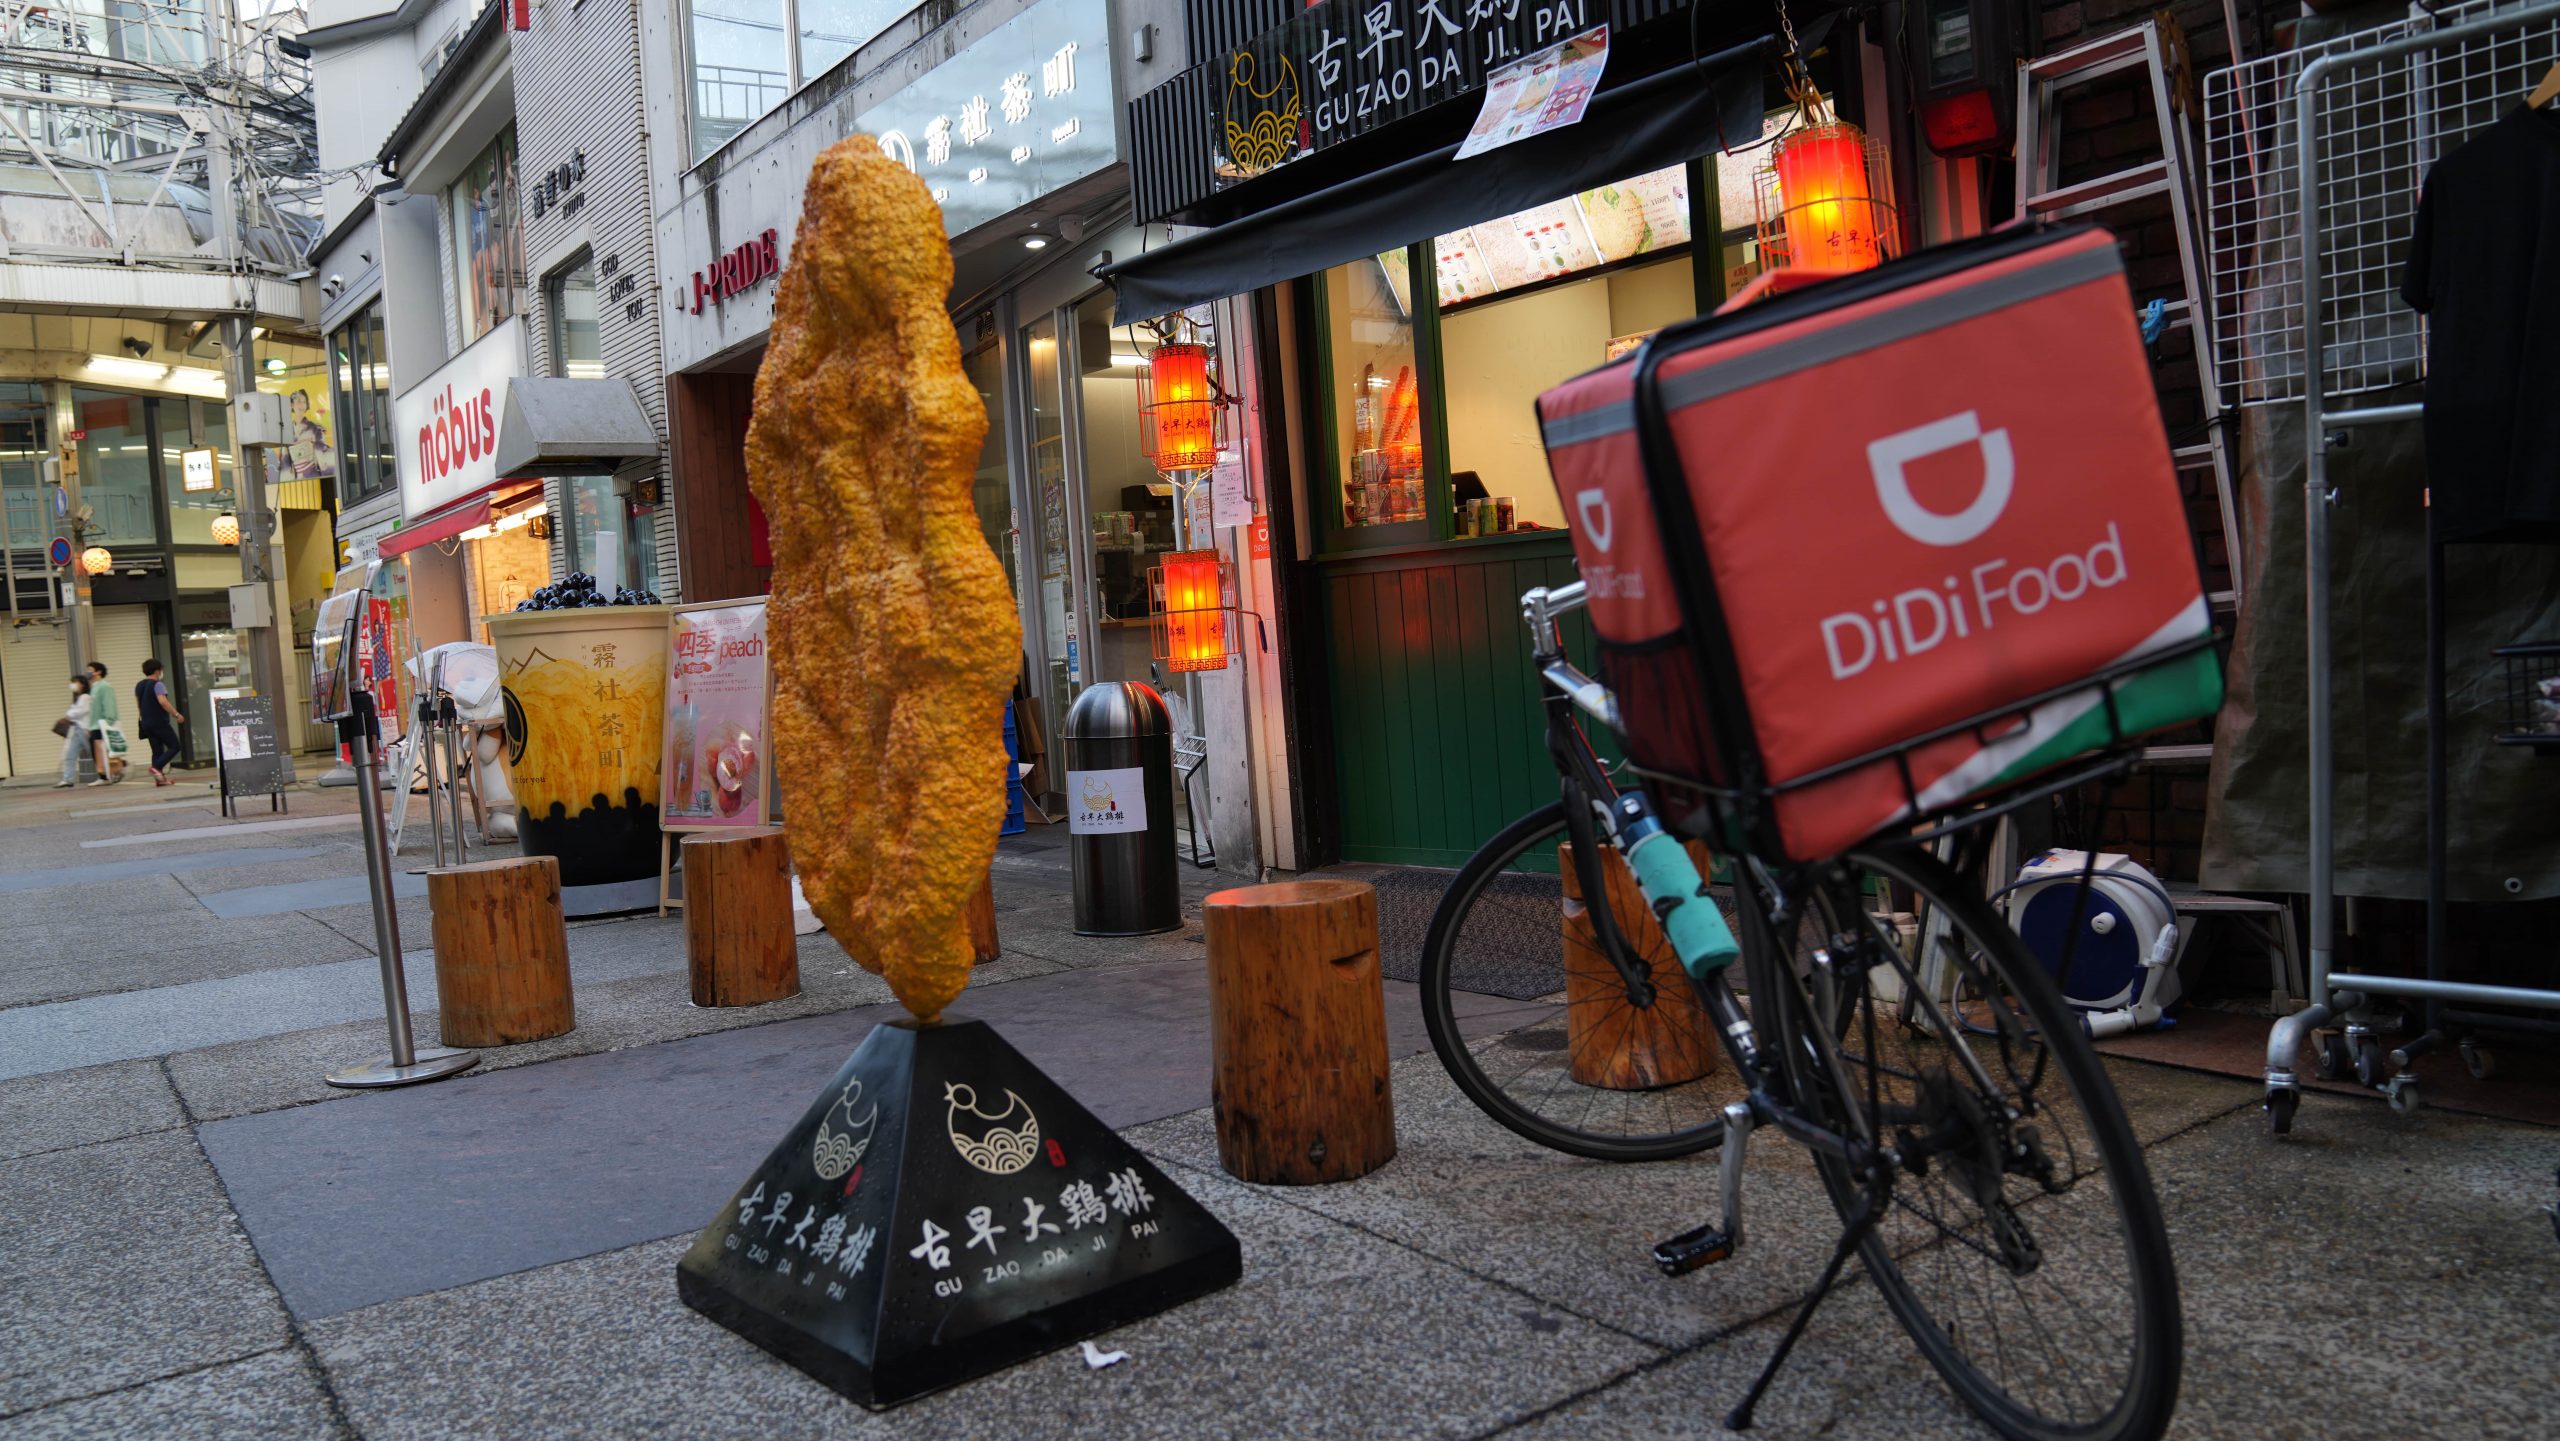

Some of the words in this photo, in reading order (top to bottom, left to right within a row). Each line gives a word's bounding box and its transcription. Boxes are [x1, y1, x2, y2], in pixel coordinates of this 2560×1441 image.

[1315, 92, 1350, 132] GU
[1356, 68, 1411, 118] ZAO
[1421, 48, 1461, 91] DA
[1536, 0, 1585, 43] PAI
[602, 254, 619, 277] GOD
[610, 274, 635, 302] LOVES
[691, 228, 779, 315] J-PRIDE
[626, 298, 643, 322] YOU
[419, 383, 495, 484] möbus
[1820, 576, 1969, 681] DiDi
[1971, 520, 2128, 629] Food
[679, 628, 716, 660] 四季
[719, 632, 763, 665] peach
[591, 643, 625, 769] 霧社茶町
[530, 776, 546, 786] you
[725, 1233, 742, 1250] GU
[746, 1244, 770, 1264] ZAO
[776, 1258, 793, 1276] DA
[825, 1281, 848, 1301] PAI
[934, 1276, 963, 1298] GU
[983, 1260, 1021, 1284] ZAO
[1042, 1247, 1069, 1266] DA
[1092, 1235, 1107, 1252] JI
[1130, 1220, 1160, 1240] PAI
